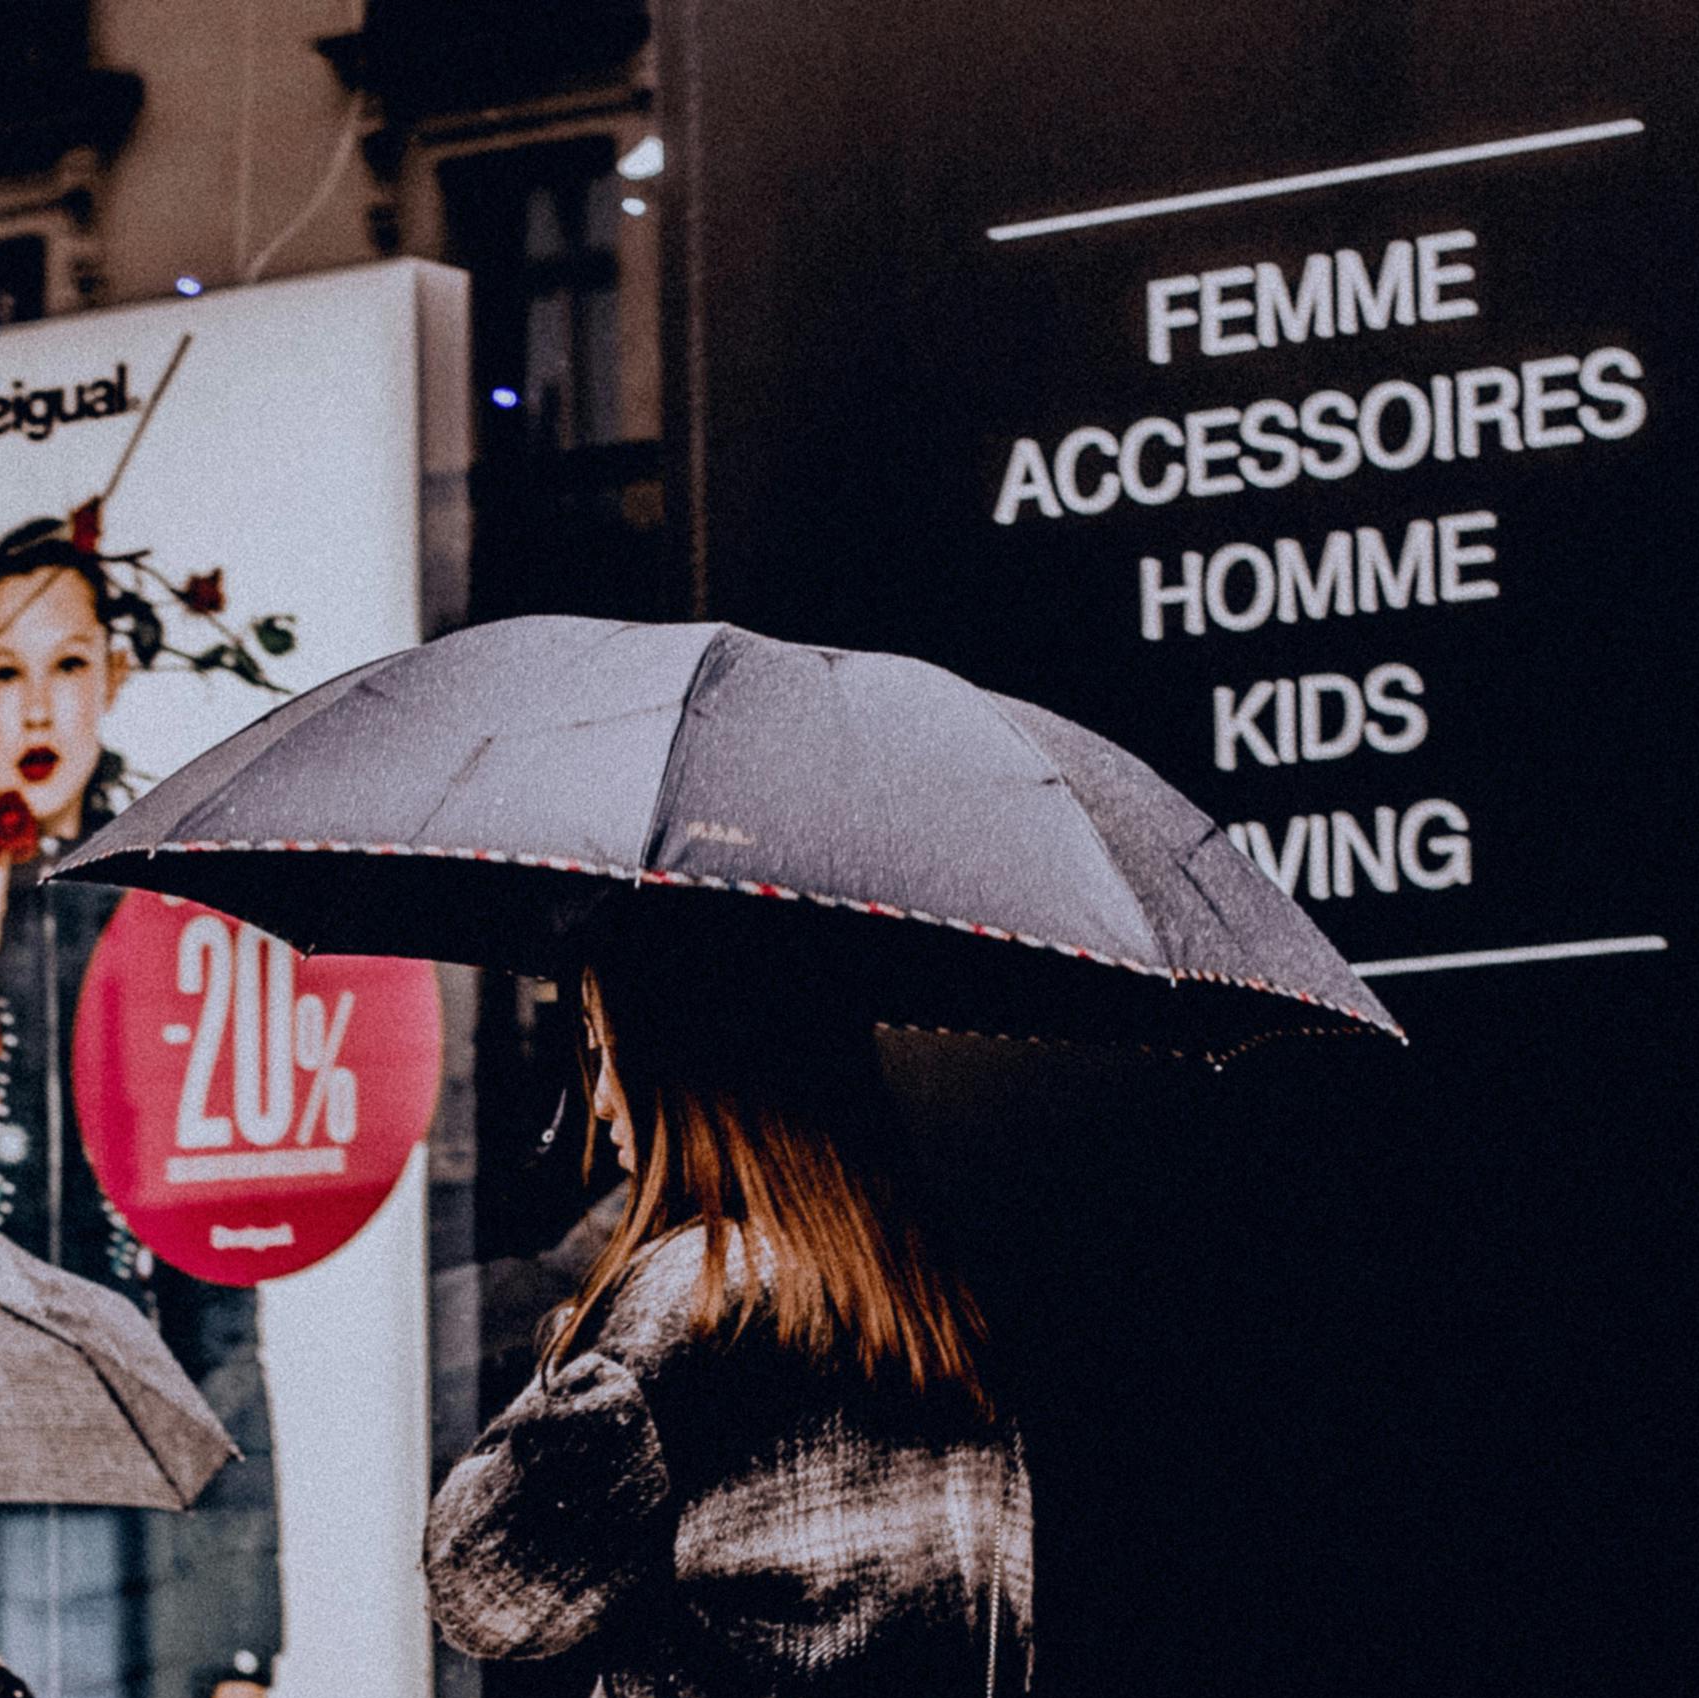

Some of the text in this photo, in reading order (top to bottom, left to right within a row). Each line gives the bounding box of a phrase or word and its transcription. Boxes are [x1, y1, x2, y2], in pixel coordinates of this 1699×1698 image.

[1145, 228, 1480, 365] FEMME
[992, 346, 1647, 526] ACCESSOIRES
[1139, 509, 1500, 641] HOMME
[1212, 663, 1429, 772] KIDS
[1226, 797, 1472, 900] VING
[161, 914, 358, 1150] -20%
